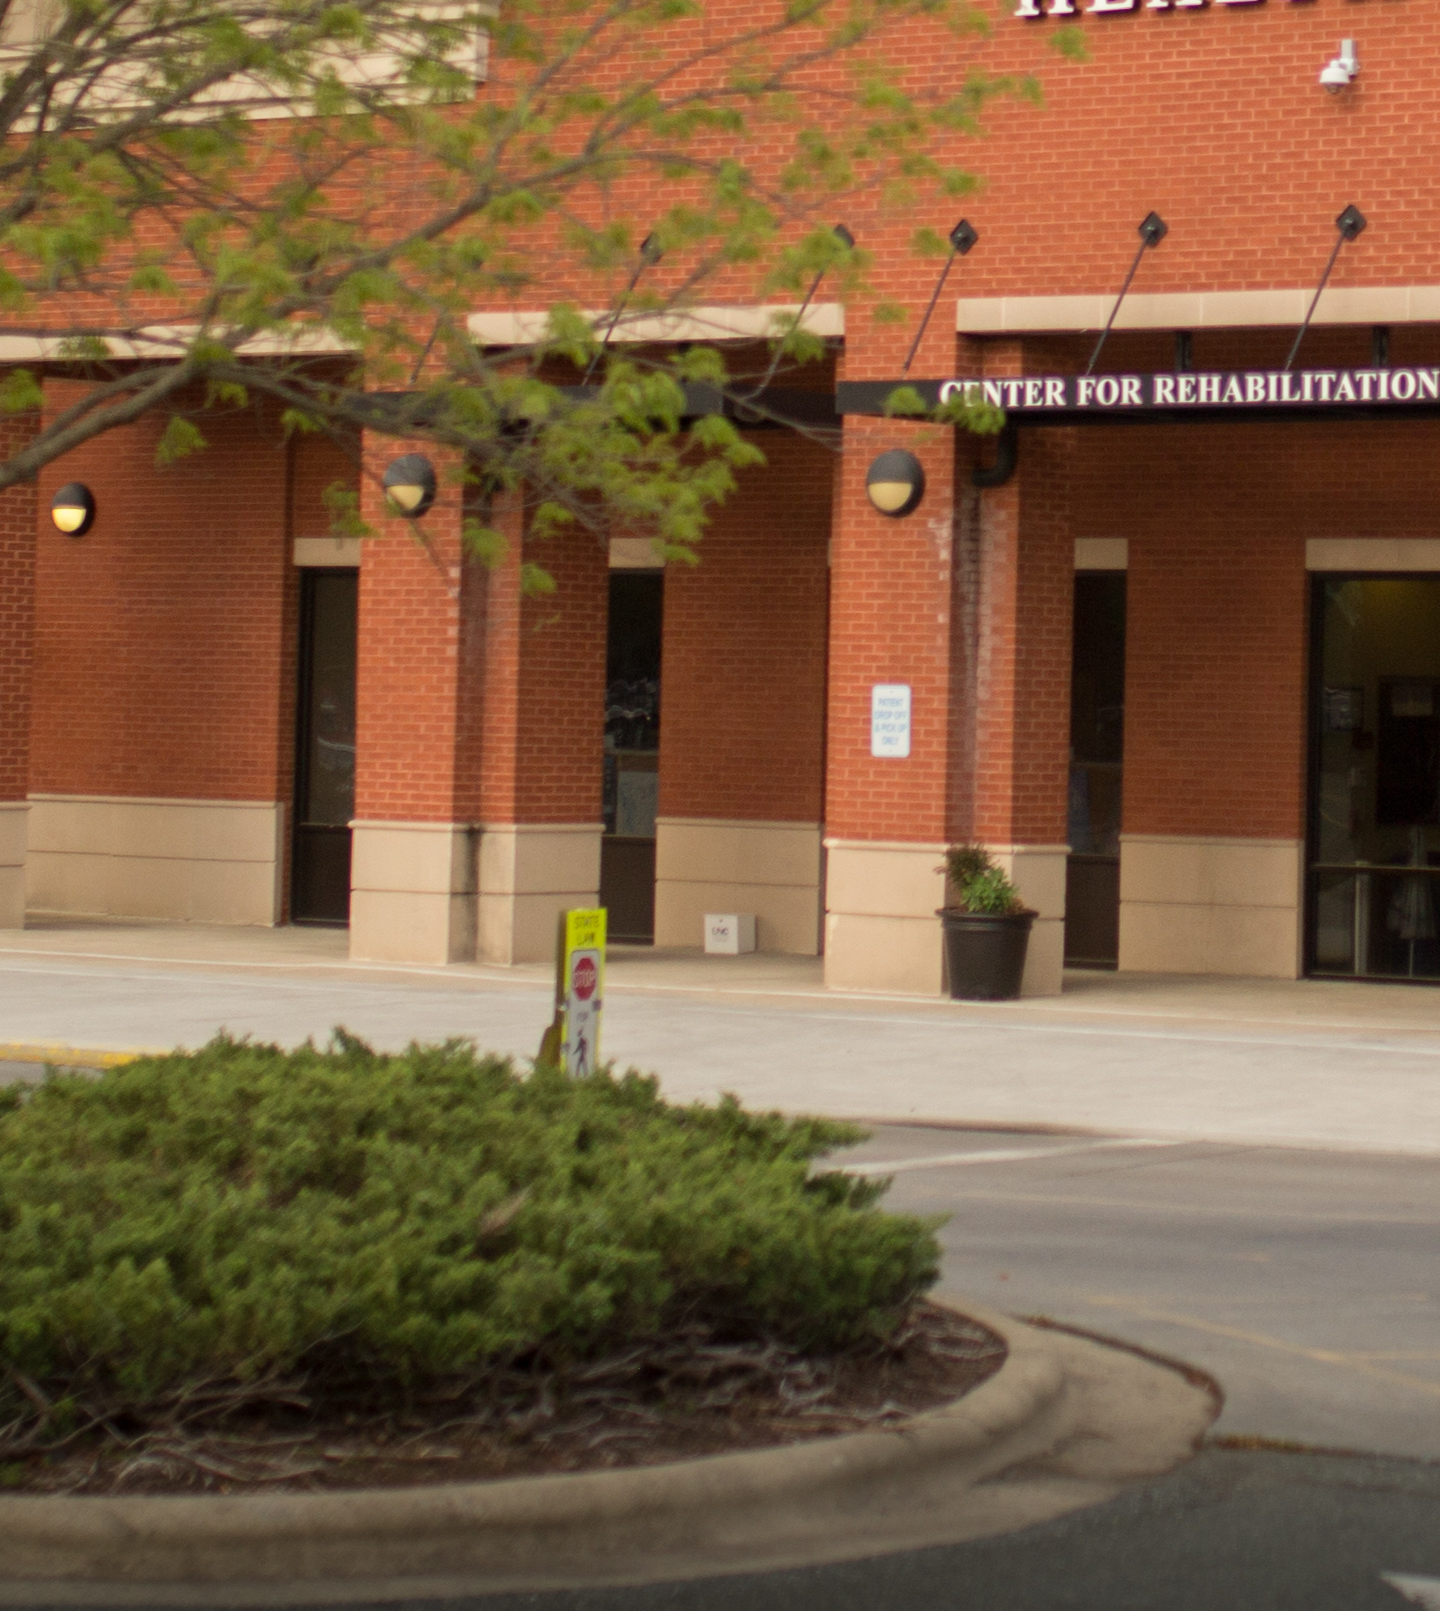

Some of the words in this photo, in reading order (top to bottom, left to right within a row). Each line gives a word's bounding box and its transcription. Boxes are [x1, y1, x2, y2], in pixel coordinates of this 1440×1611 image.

[939, 377, 1067, 408] CENTER
[1076, 376, 1143, 406] FOR
[1153, 369, 1440, 404] REHABILITATION
[878, 698, 904, 707] PATIENT
[874, 711, 893, 720] DROP
[881, 723, 896, 732] PICK
[882, 736, 899, 745] ONLY
[573, 915, 600, 930] STATE
[573, 970, 596, 989] STOP
